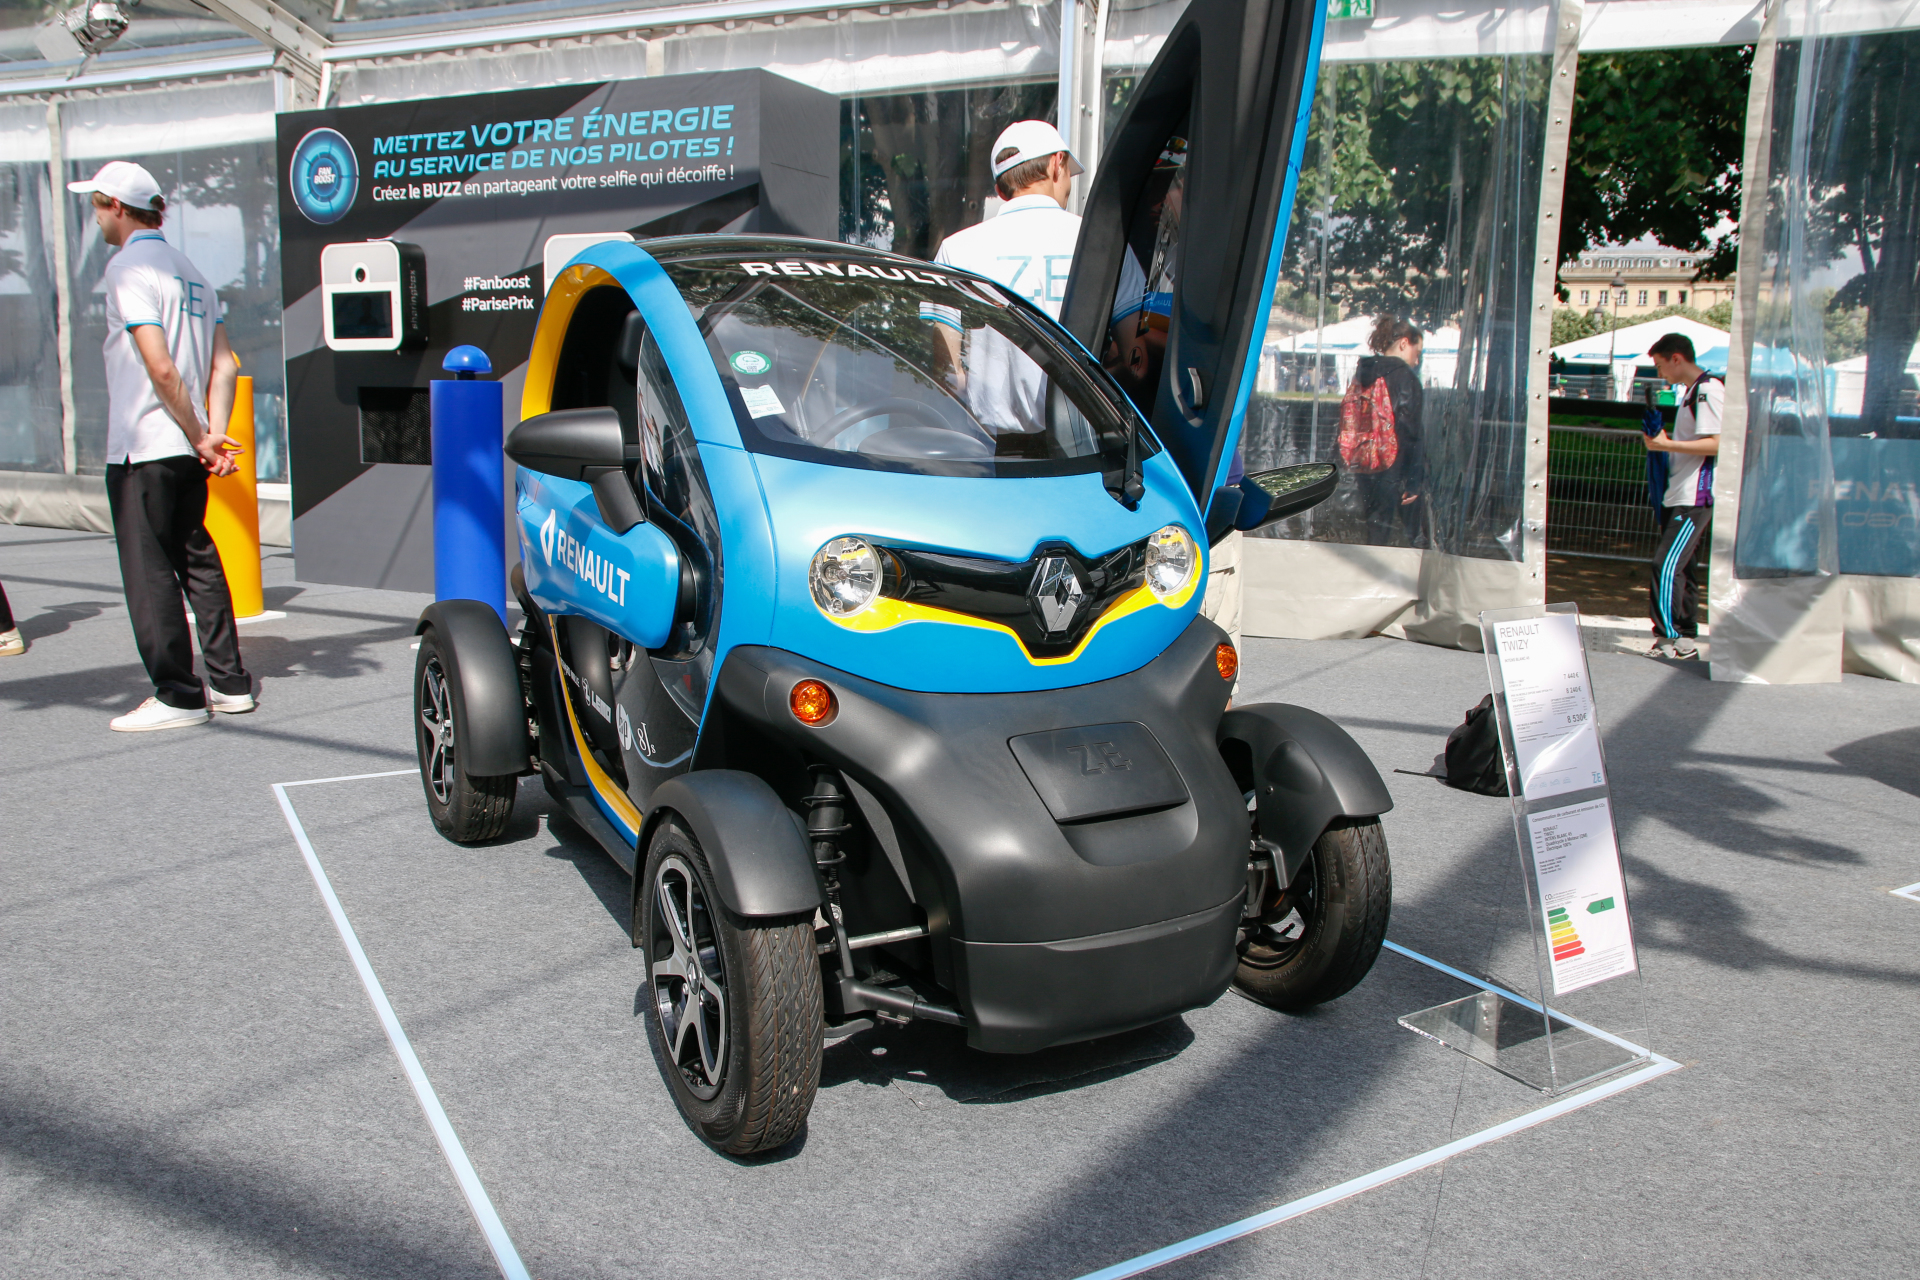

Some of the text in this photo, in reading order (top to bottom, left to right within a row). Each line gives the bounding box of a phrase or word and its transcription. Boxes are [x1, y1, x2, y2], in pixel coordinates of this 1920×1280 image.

[373, 105, 735, 155] METTEZ VOTRE ÉNERGIE
[374, 135, 735, 178] AU SERVICE DE NOS PILOTES !
[313, 174, 336, 185] BOOST
[318, 167, 333, 176] FAN
[372, 184, 407, 201] Créez
[408, 183, 421, 199] le
[422, 181, 463, 198] BUZZ
[464, 182, 481, 196] en
[483, 175, 559, 198] partageant
[560, 174, 597, 190] votre
[600, 170, 637, 188] selfie
[640, 168, 663, 189] qui
[666, 164, 727, 184] décoiffe
[739, 262, 948, 287] RENAULT
[463, 275, 532, 292] #Fanboost
[462, 295, 535, 312] #ParisePrix
[557, 528, 631, 607] RENAULT
[1500, 624, 1539, 638] RENAULT
[1502, 639, 1528, 651] TWIZY
[1600, 901, 1606, 910] A
